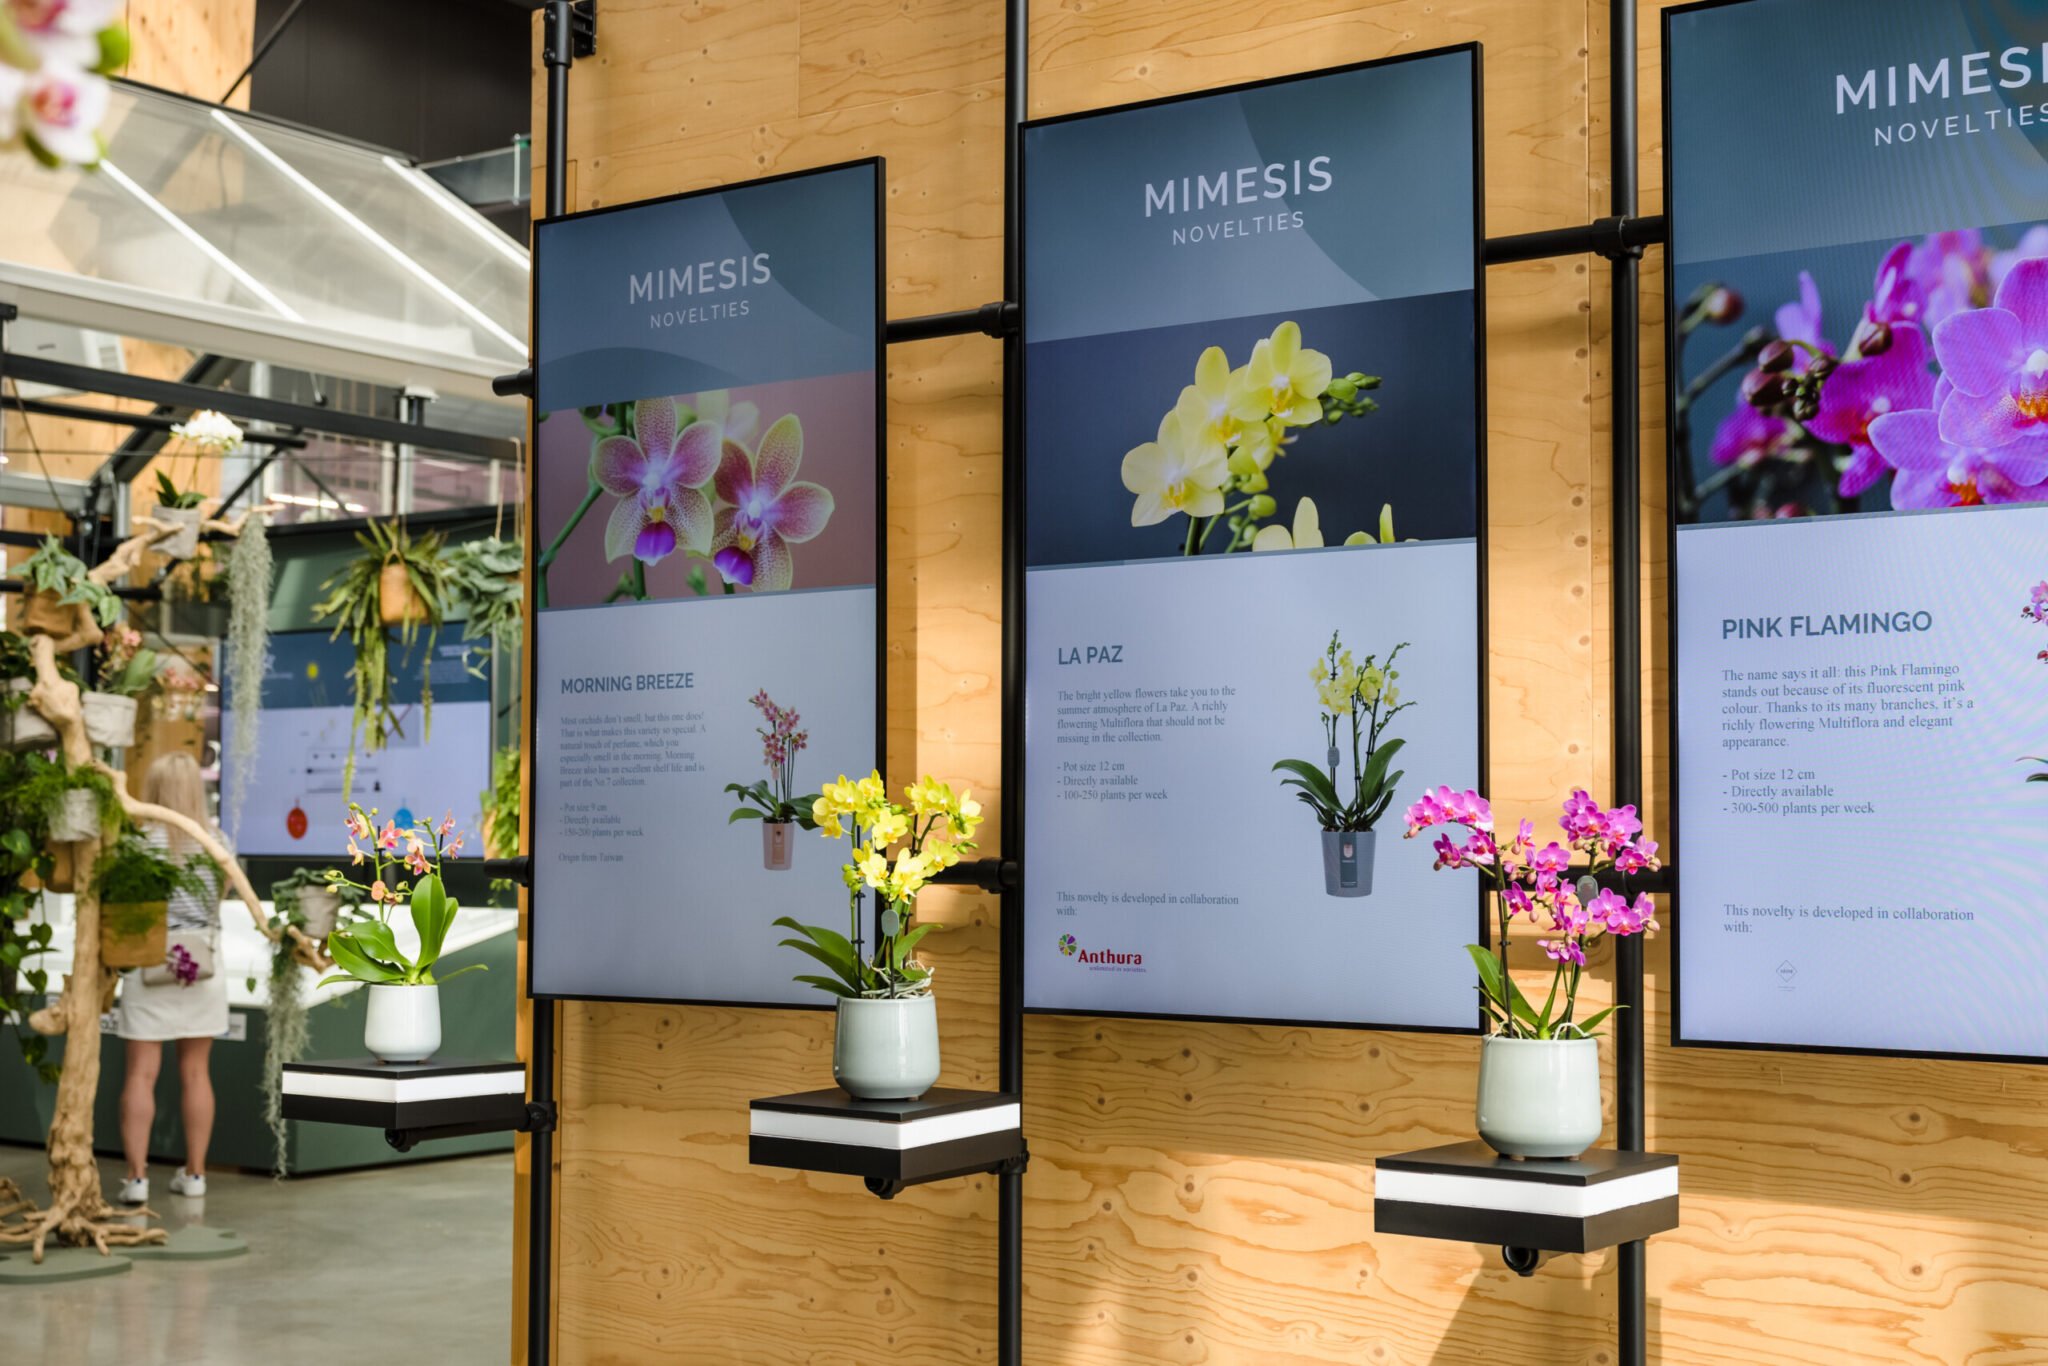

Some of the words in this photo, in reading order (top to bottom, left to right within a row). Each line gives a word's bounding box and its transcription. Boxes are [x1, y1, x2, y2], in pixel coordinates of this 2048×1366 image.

[1145, 156, 1332, 217] MIMESIS
[1173, 211, 1304, 245] NOVELTIES
[630, 253, 770, 304] MIMESIS
[650, 301, 749, 328] NOVELTIES
[1722, 617, 1782, 639] PINK
[1790, 611, 1932, 636] FLAMINGO
[1059, 648, 1081, 665] LA
[1087, 646, 1122, 663] PAZ
[1722, 669, 1744, 681] The
[1748, 672, 1777, 680] name
[1782, 671, 1807, 683] says
[1810, 667, 1818, 678] it
[1822, 666, 1841, 678] all:
[1845, 666, 1866, 677] this
[1870, 665, 1897, 676] Pink
[1902, 663, 1959, 679] Flamingo
[561, 676, 632, 694] MORNING
[637, 673, 694, 690] BREEZE
[1722, 686, 1757, 698] stands
[1761, 685, 1779, 697] out
[1783, 684, 1829, 696] because
[1833, 683, 1846, 695] of
[1849, 683, 1862, 694] its
[1867, 681, 1933, 693] fluorescent
[1938, 680, 1965, 695] pink
[1058, 691, 1073, 701] The
[1076, 691, 1101, 703] bright
[1104, 690, 1131, 702] yellow
[1136, 689, 1167, 698] flowers
[1170, 688, 1188, 697] take
[1190, 690, 1207, 700] you
[1210, 687, 1219, 696] to
[1222, 686, 1235, 696] the
[1093, 704, 1141, 717] atmosphere
[1144, 703, 1154, 713] of
[1156, 703, 1167, 712] La
[1192, 702, 1199, 711] A
[1202, 701, 1228, 714] richly
[1722, 702, 1761, 714] colour.
[1767, 701, 1807, 713] Thanks
[1811, 700, 1823, 712] to
[1827, 700, 1840, 711] its
[1844, 703, 1876, 714] many
[1881, 698, 1939, 713] branches,
[1057, 719, 1097, 731] flowering
[1100, 718, 1144, 727] Multiflora
[1147, 717, 1163, 727] that
[1166, 716, 1194, 726] should
[1197, 716, 1212, 725] not
[1214, 716, 1225, 725] be
[1722, 719, 1754, 734] richly
[1759, 718, 1815, 733] flowering
[1819, 717, 1879, 729] Multiflora
[1883, 716, 1905, 728] and
[1909, 715, 1953, 731] elegant
[1057, 734, 1089, 746] missing
[1092, 734, 1100, 742] in
[1103, 733, 1115, 742] the
[1118, 732, 1162, 742] collection.
[1722, 739, 1790, 751] appearance.
[1063, 762, 1077, 771] Pot
[1080, 762, 1096, 771] size
[1099, 761, 1109, 771] 12
[1063, 776, 1097, 789] Directly
[1100, 776, 1138, 785] available
[1731, 769, 1750, 780] Pot
[1753, 769, 1776, 780] size
[1780, 769, 1793, 780] 12
[1797, 772, 1815, 780] cm
[1064, 790, 1098, 800] 100-250
[1101, 790, 1126, 802] plants
[1129, 793, 1142, 802] per
[1145, 790, 1168, 799] week
[1731, 786, 1777, 800] Directly
[1781, 785, 1834, 796] available
[1731, 802, 1779, 813] 300-500
[1783, 802, 1817, 817] plants
[1821, 806, 1840, 817] per
[1844, 802, 1875, 813] week
[1056, 892, 1075, 901] This
[1077, 892, 1108, 905] novelty
[1112, 893, 1119, 902] is
[1122, 893, 1166, 906] developed
[1168, 894, 1177, 903] in
[1179, 894, 1239, 904] collaboration
[1056, 906, 1077, 916] with:
[1724, 904, 1749, 916] This
[1752, 905, 1795, 920] novelty
[1800, 906, 1809, 917] is
[1813, 906, 1873, 922] developed
[1877, 908, 1888, 918] in
[1893, 908, 1974, 920] collaboration
[1724, 921, 1752, 933] with:
[1078, 949, 1142, 965] Anthura
